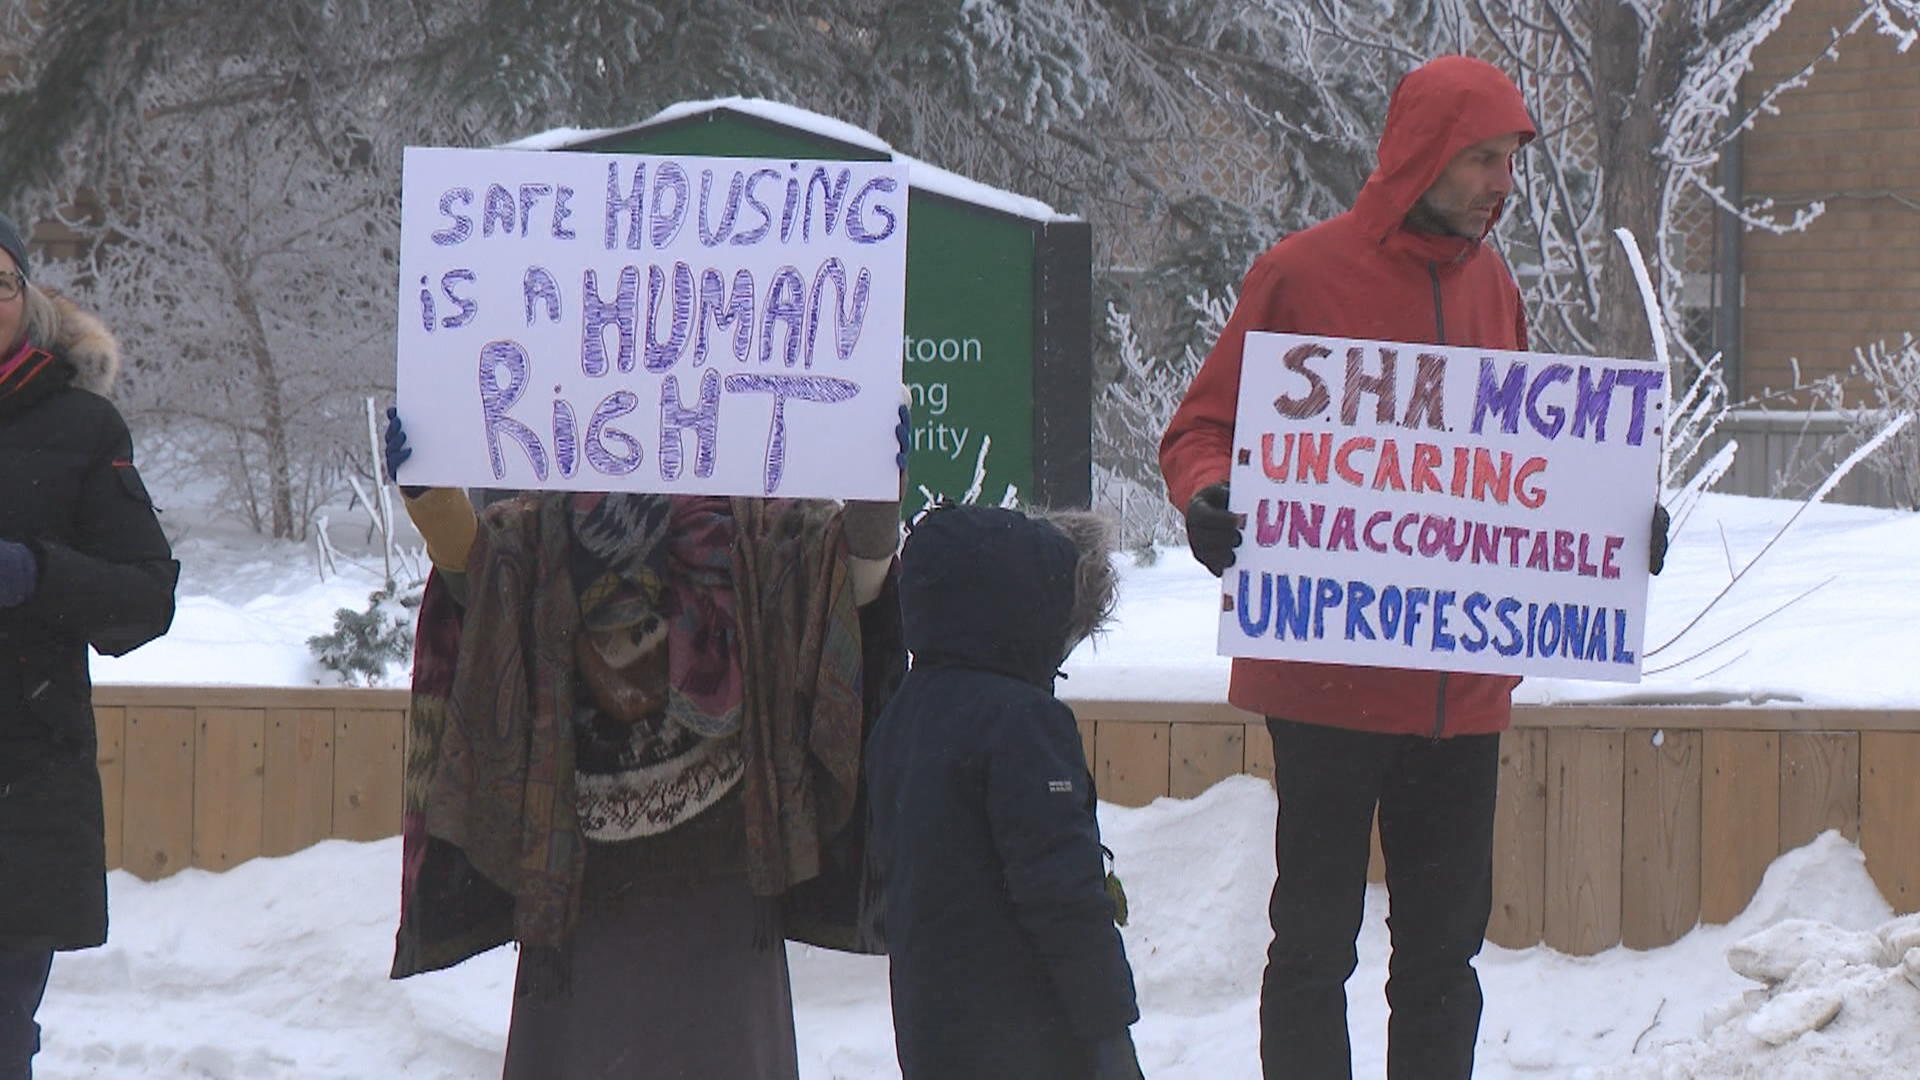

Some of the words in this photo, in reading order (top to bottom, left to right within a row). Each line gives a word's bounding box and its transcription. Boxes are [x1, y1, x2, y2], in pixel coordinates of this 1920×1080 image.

[430, 182, 575, 246] SAFE
[523, 265, 561, 327] A
[581, 257, 872, 377] HUMAN
[1273, 342, 1454, 433] S.H.A.
[909, 421, 969, 460] rity
[1260, 432, 1549, 510] UNCARING
[1255, 498, 1626, 580] UNACCOUNTABLE
[1237, 569, 1636, 665] UNPROFESSIONAL
